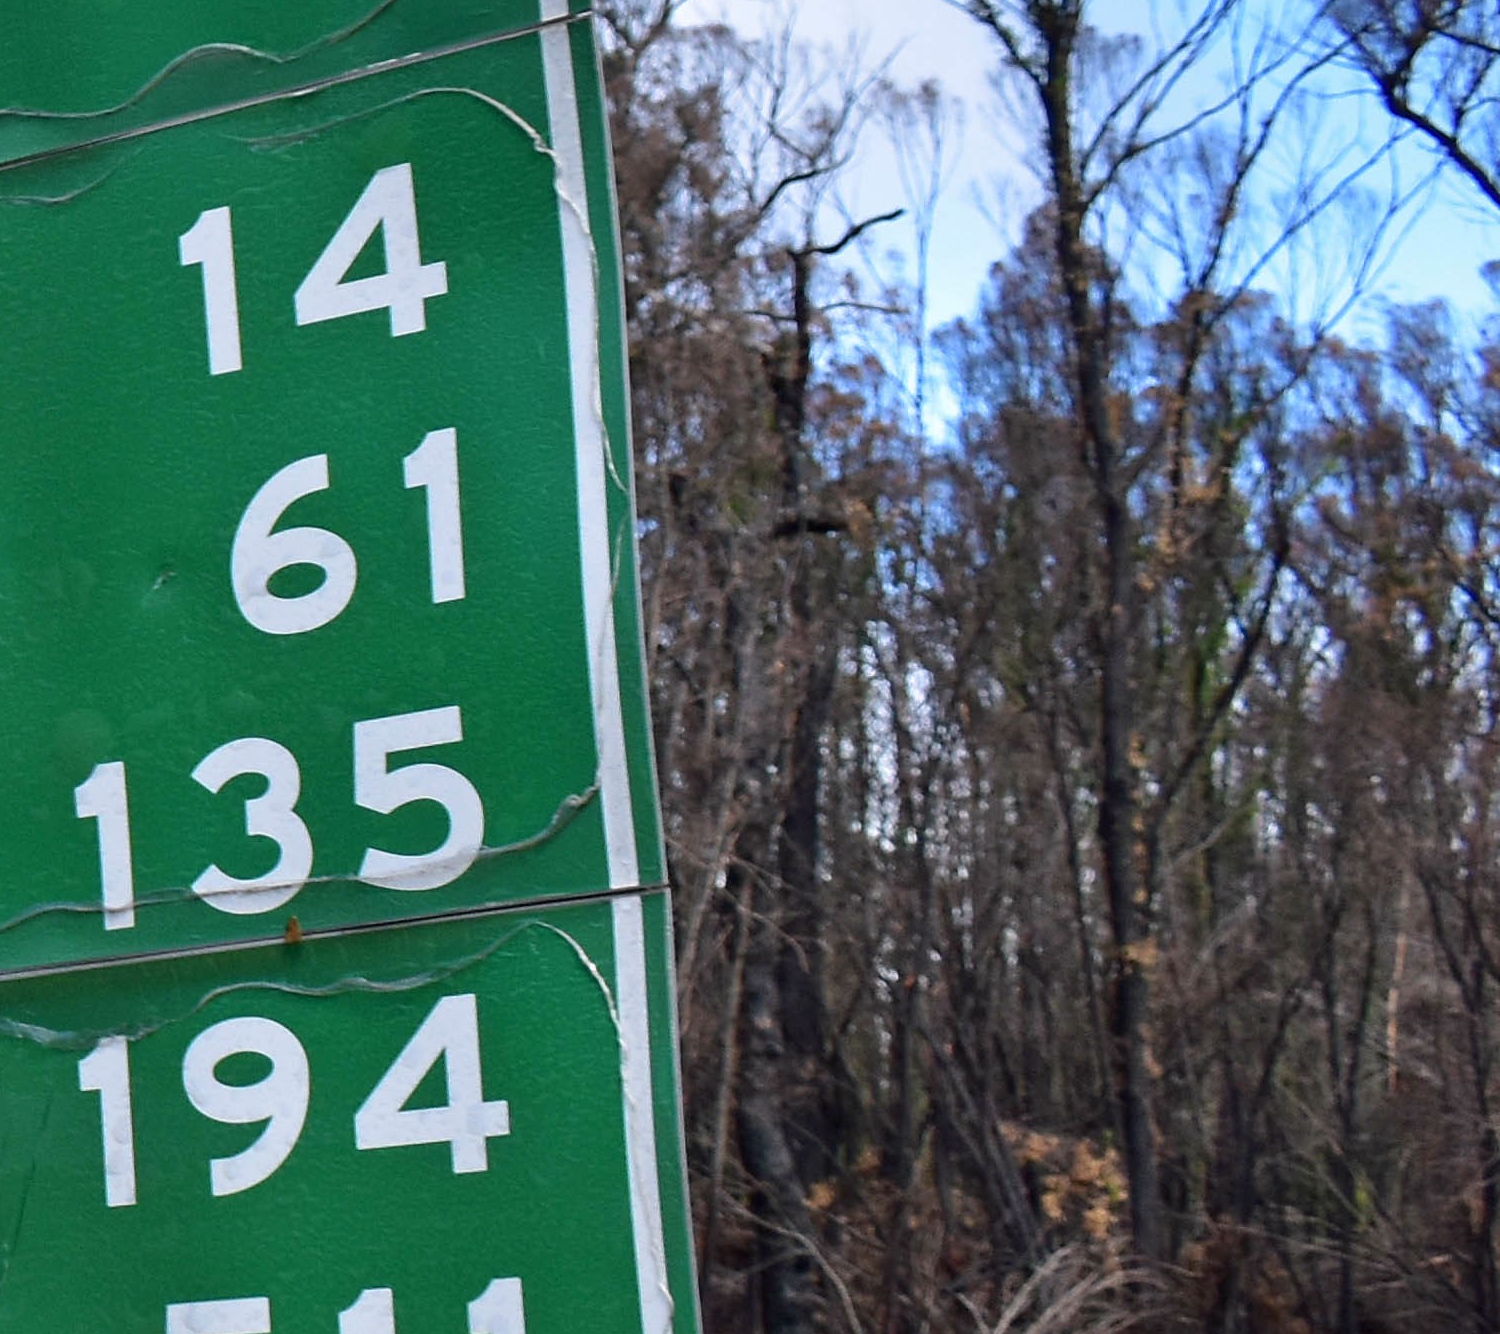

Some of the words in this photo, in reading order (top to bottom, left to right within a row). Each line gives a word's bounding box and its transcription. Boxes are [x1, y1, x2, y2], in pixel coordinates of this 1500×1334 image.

[181, 163, 447, 374] 14
[233, 428, 464, 634] 61
[76, 706, 483, 929] 135
[80, 994, 509, 1206] 194
